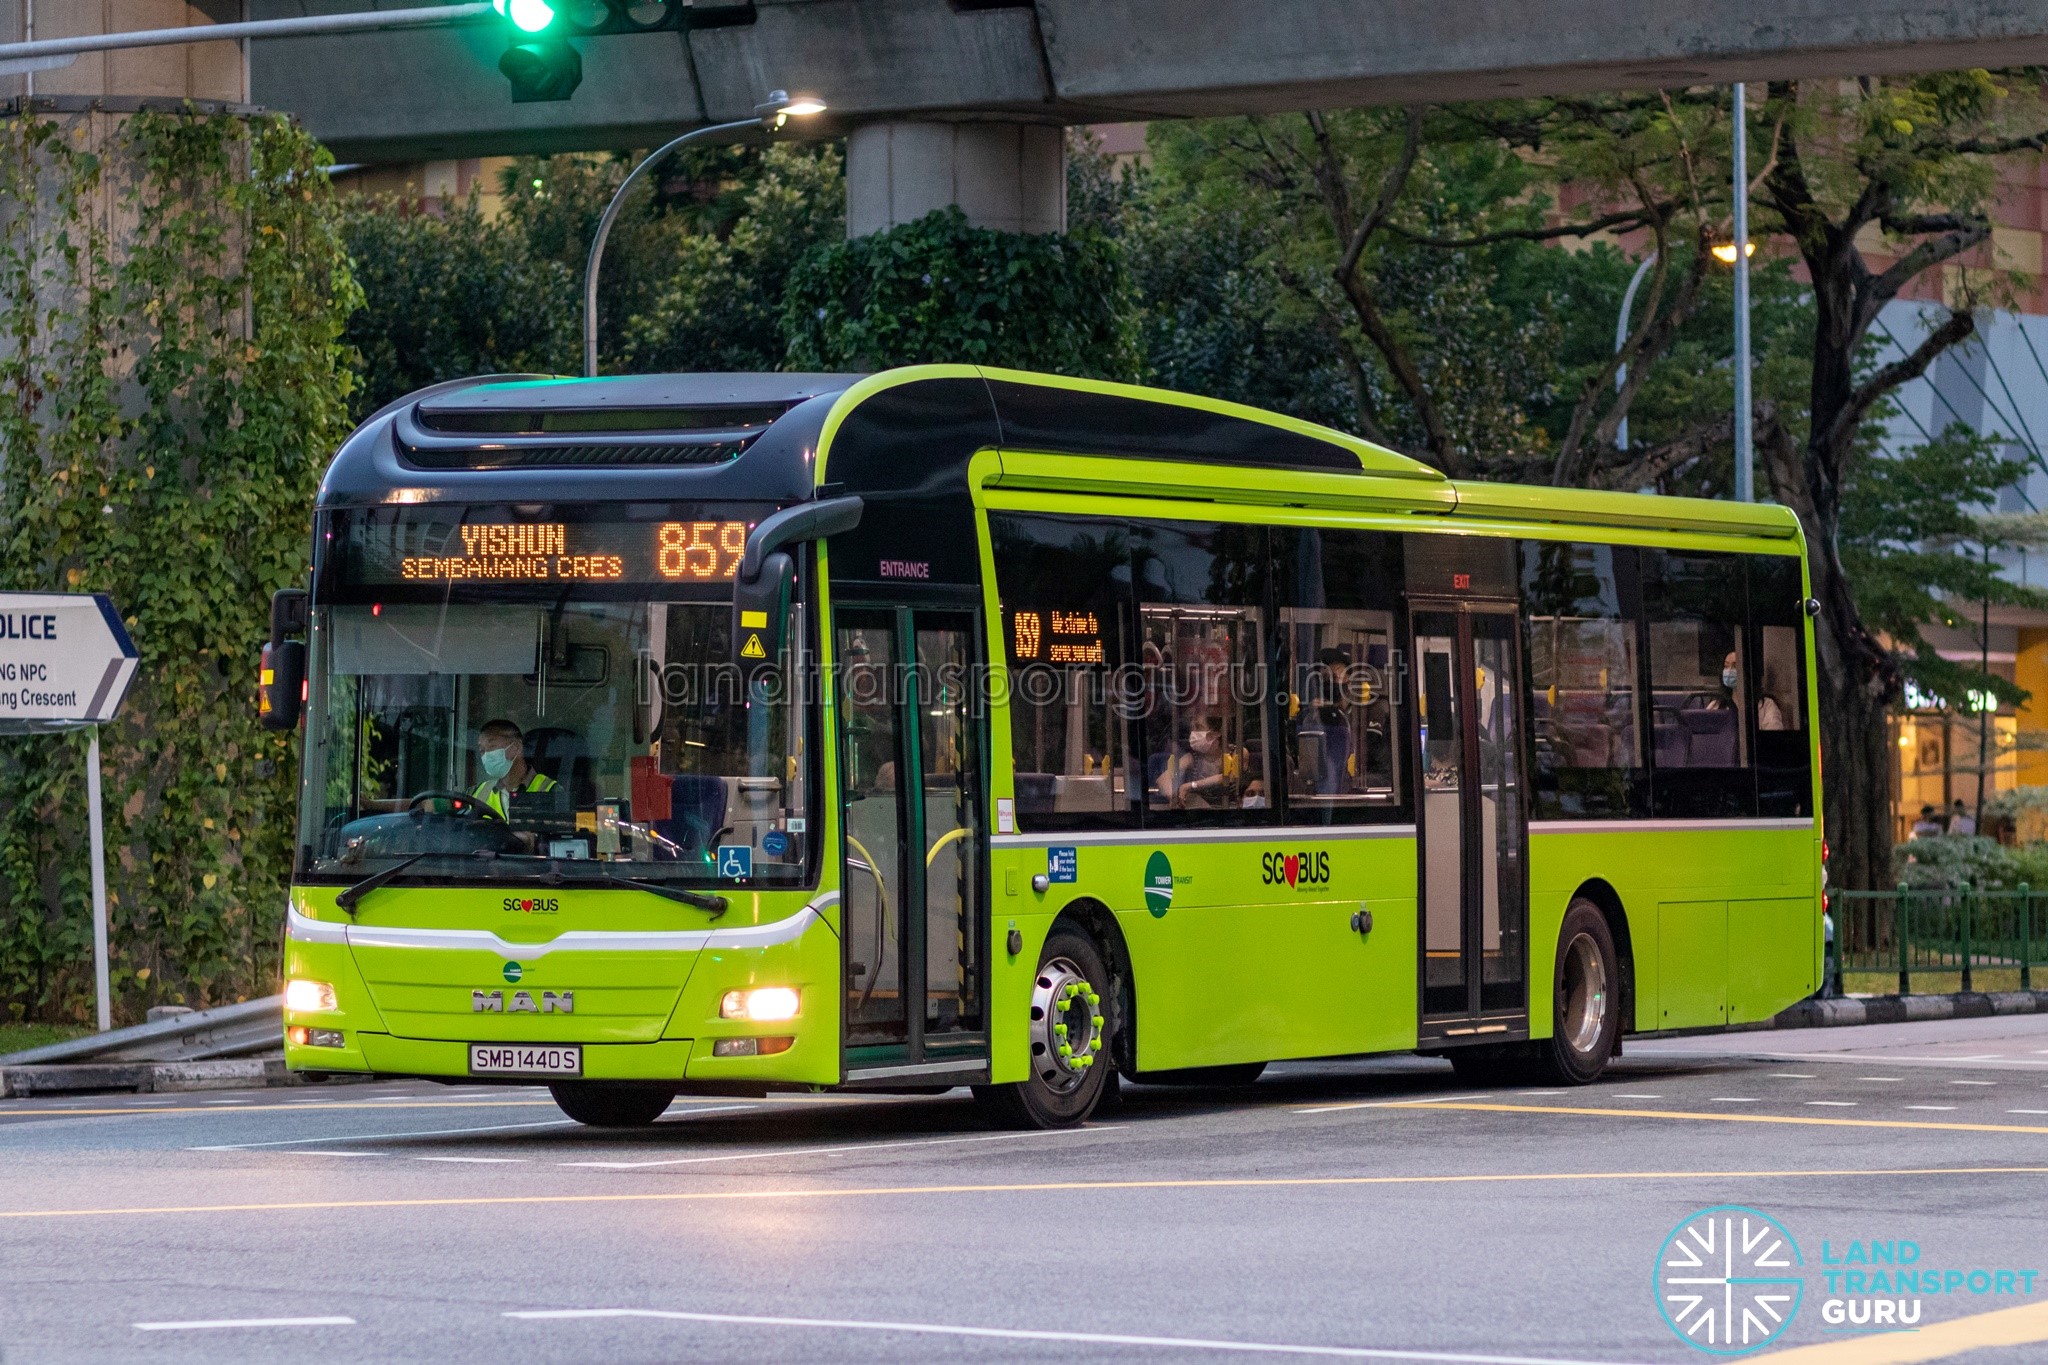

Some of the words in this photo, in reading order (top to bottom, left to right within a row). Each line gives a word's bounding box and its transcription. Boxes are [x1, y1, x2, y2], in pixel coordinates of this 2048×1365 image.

[461, 524, 565, 556] YISHUN
[659, 523, 745, 577] 859
[402, 557, 549, 579] SEMBAWANG
[556, 556, 623, 578] CRES
[880, 560, 930, 578] ENTRANCE
[1453, 574, 1471, 589] EXIT
[1014, 611, 1040, 658] 859
[20, 664, 47, 681] NPC
[0, 692, 18, 710] ng
[21, 688, 77, 707] Crescent
[1155, 876, 1172, 885] TOWER
[472, 989, 575, 1013] MAN
[476, 1049, 576, 1069] SMB1440S
